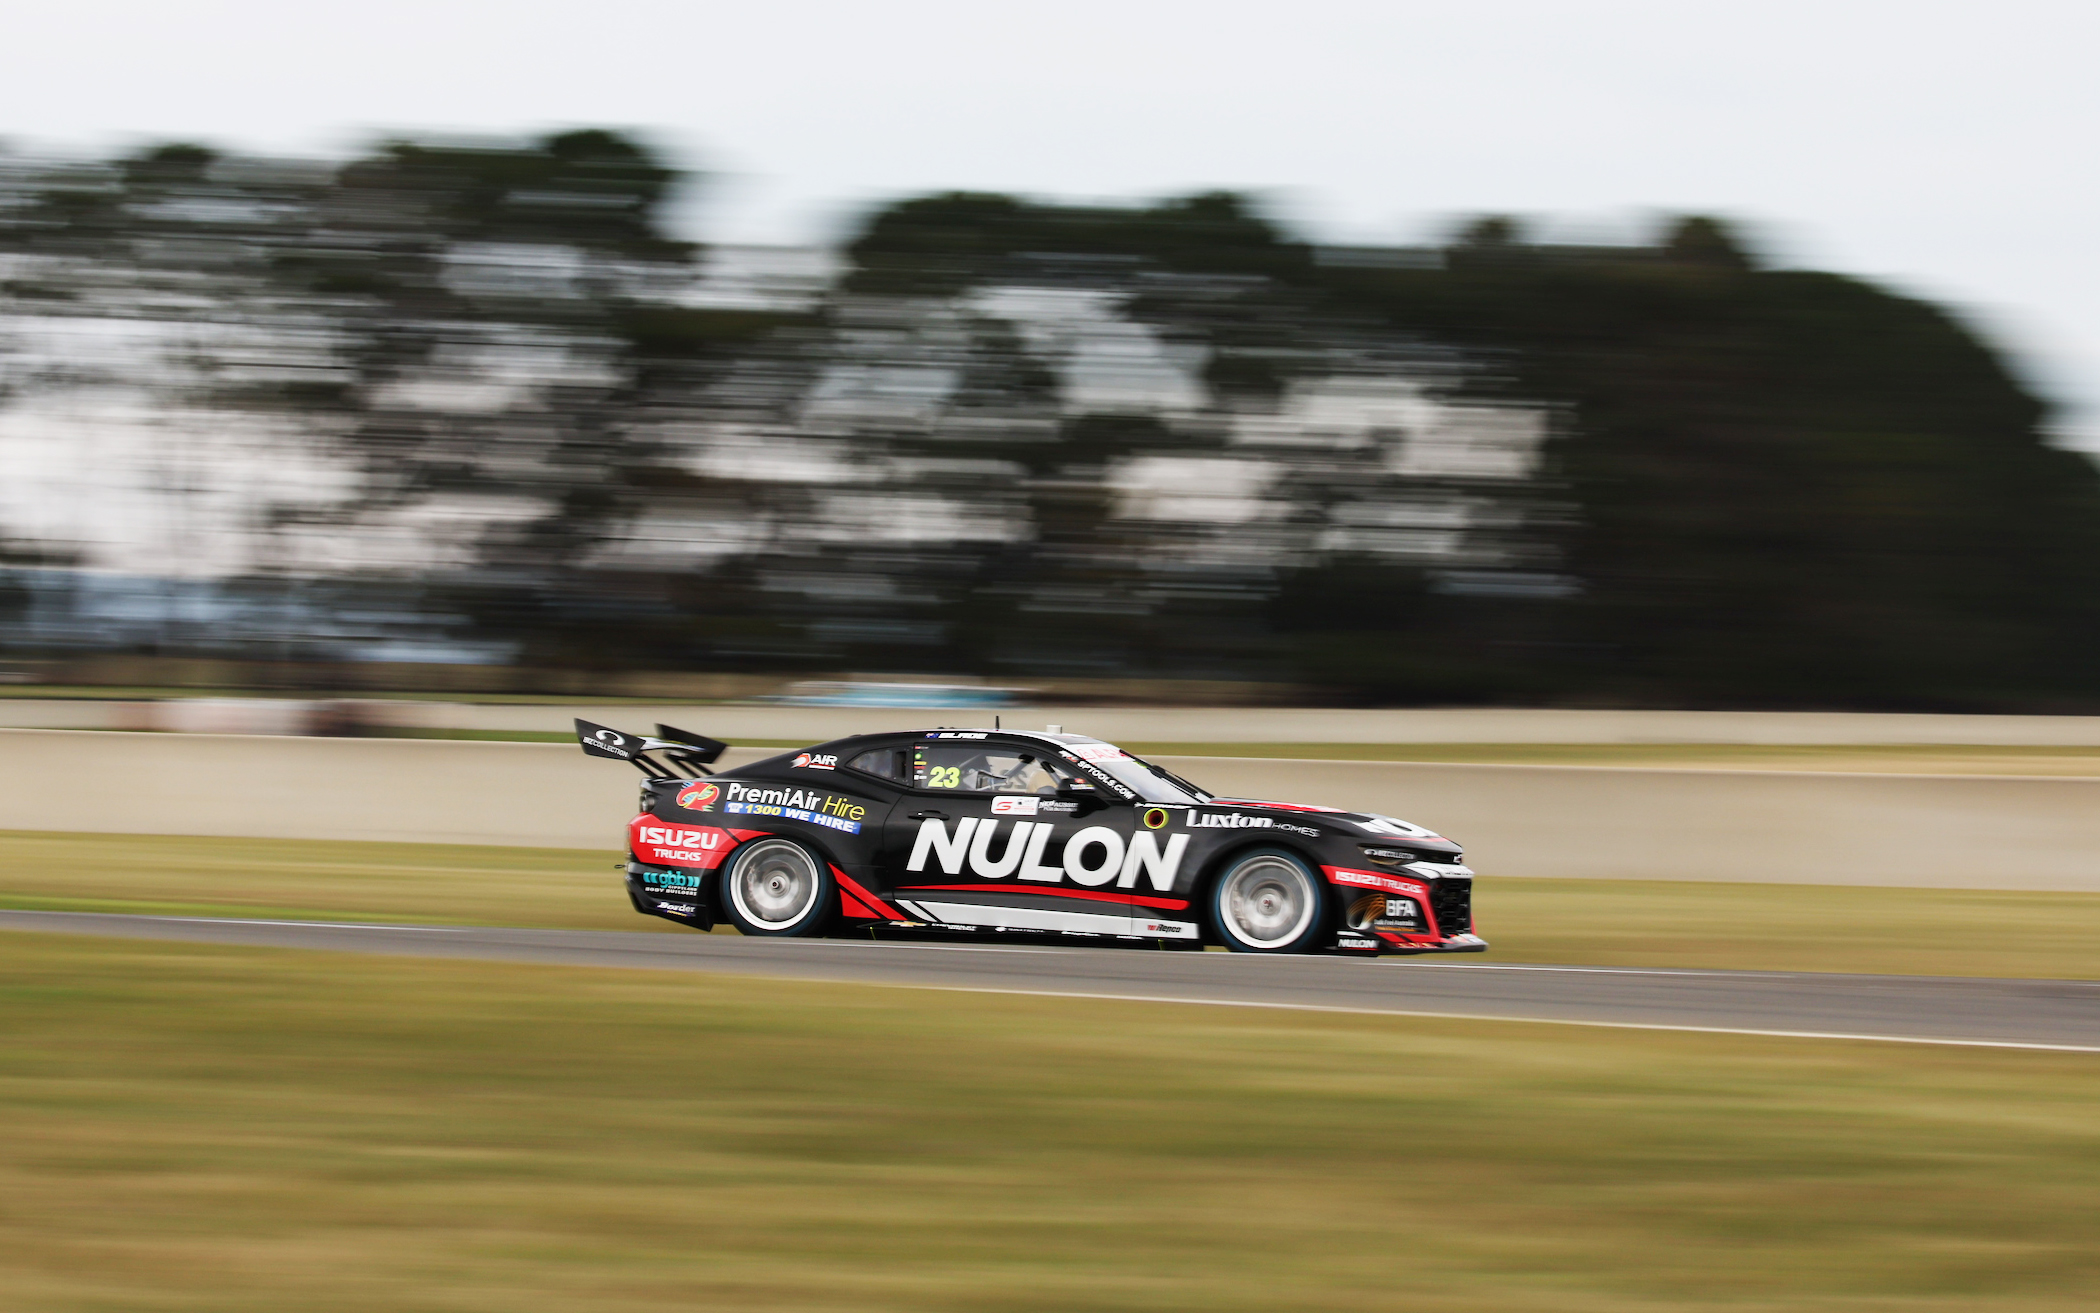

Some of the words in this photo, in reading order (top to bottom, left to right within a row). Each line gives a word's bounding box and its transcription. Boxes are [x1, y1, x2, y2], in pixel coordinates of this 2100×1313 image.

[811, 754, 837, 766] AIR
[928, 766, 960, 788] 23
[1077, 760, 1136, 799] SPTOOLS.COM
[727, 782, 821, 810] PremiAir
[821, 796, 865, 820] Hire
[745, 804, 782, 815] 1300
[785, 808, 811, 821] WE
[813, 813, 855, 832] HIRE
[1186, 809, 1274, 828] Luxton
[1272, 822, 1321, 838] HOMES
[639, 826, 719, 850] ISUZU
[653, 848, 702, 861] TRUCKS
[906, 816, 1191, 891] NULON
[666, 888, 698, 896] BUILDERS
[1335, 871, 1382, 886] ISUZU
[1382, 878, 1424, 894] TRUCKS
[657, 901, 696, 913] Border
[1386, 899, 1418, 917] BFA
[1156, 924, 1182, 934] Repco
[1338, 938, 1379, 949] NULON
